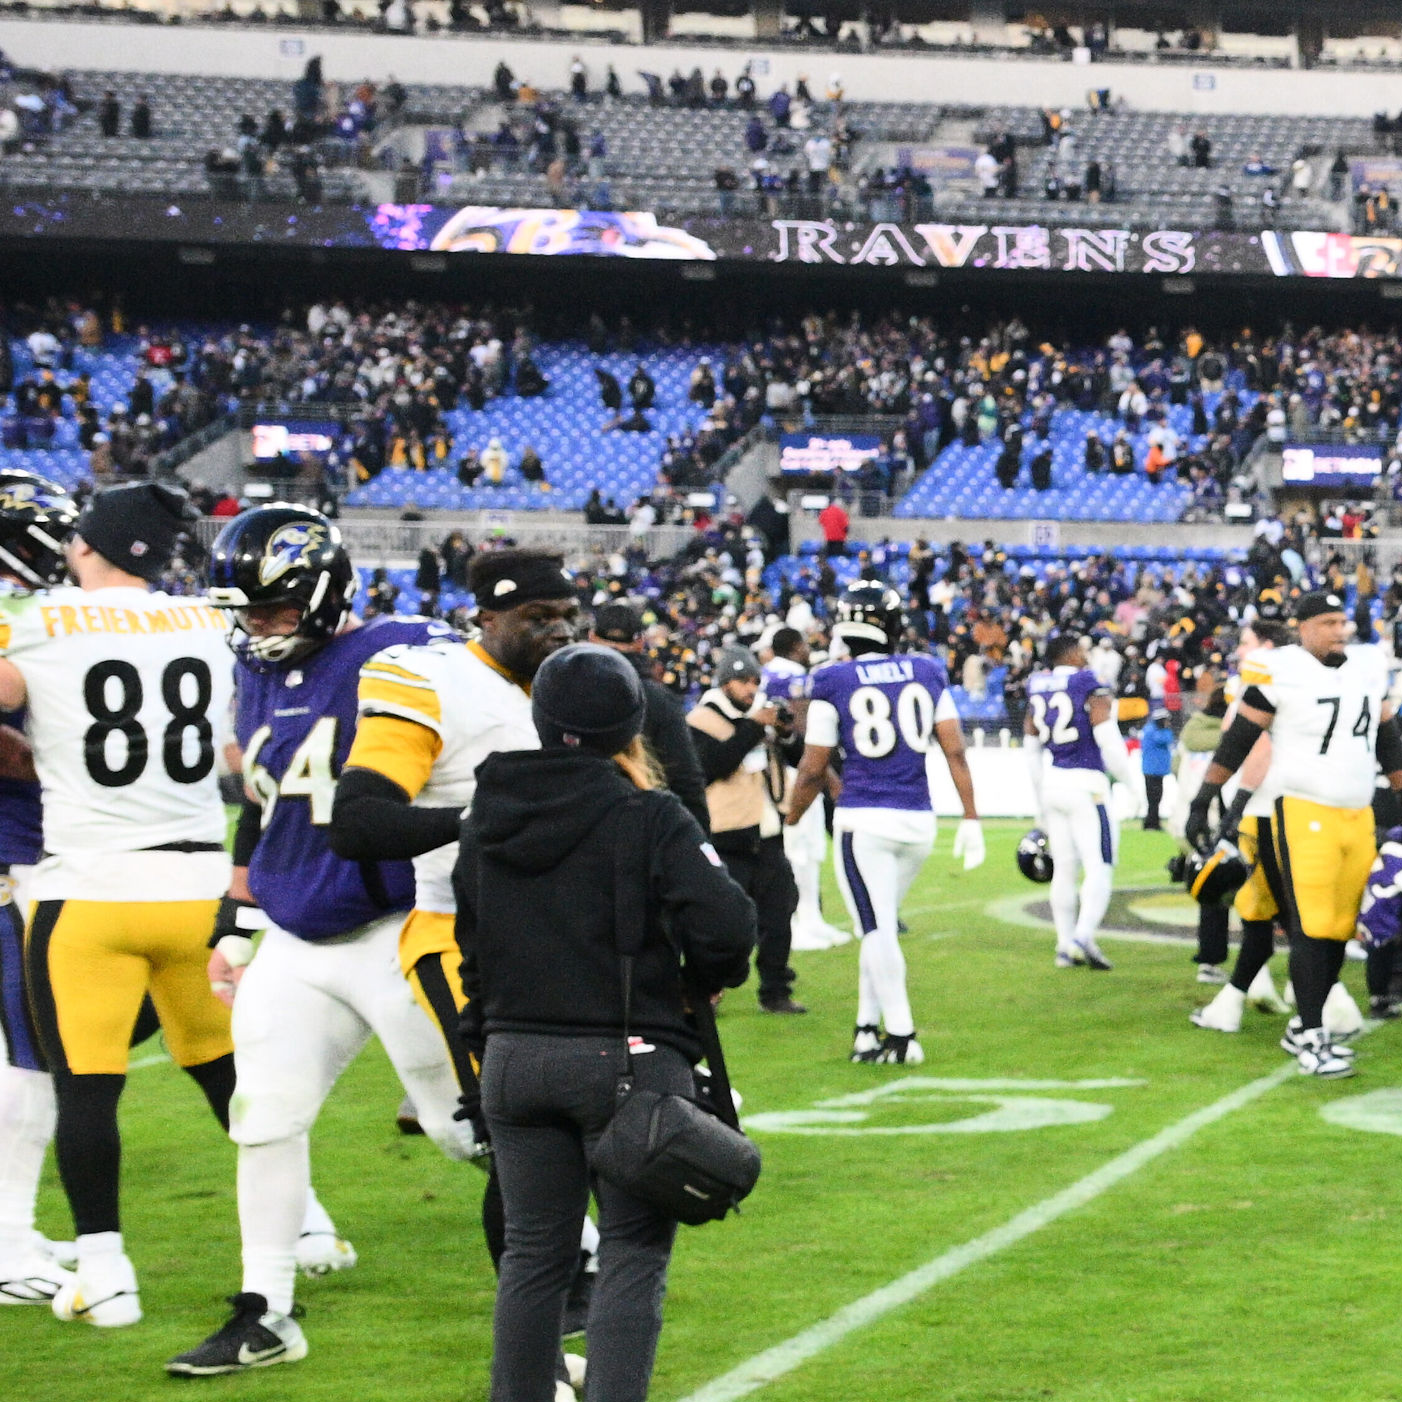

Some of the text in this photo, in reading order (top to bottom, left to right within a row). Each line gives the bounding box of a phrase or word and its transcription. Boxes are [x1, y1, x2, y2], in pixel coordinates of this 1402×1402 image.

[771, 219, 1197, 275] RAVENS
[40, 605, 228, 637] FREIERMUTH
[84, 656, 215, 788] 88
[848, 682, 934, 759] 80
[1317, 695, 1371, 755] 74
